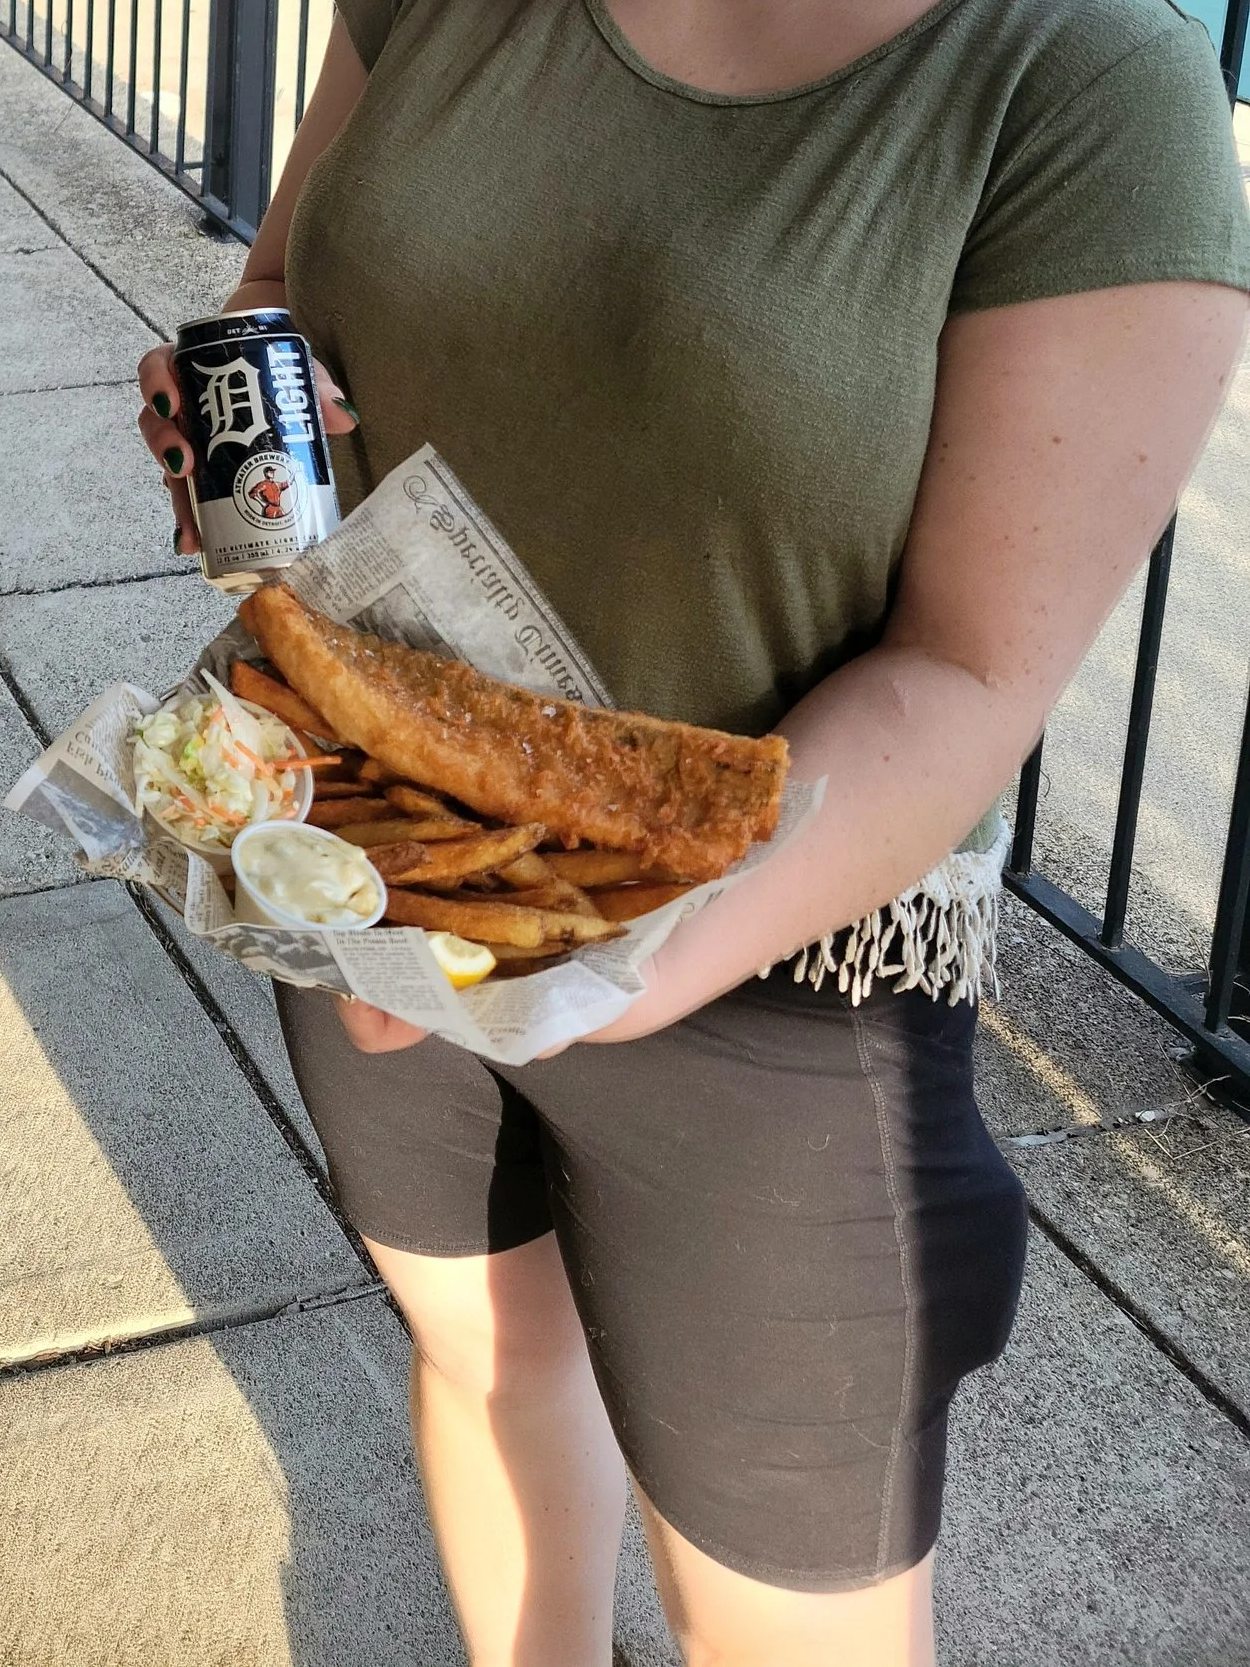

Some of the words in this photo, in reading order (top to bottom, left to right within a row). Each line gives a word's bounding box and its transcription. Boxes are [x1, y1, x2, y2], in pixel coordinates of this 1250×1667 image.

[266, 341, 315, 443] LIGHT
[234, 460, 253, 494] ATWATER
[253, 454, 289, 464] BREWERY
[230, 540, 270, 552] ULTIMATE
[274, 536, 298, 545] LIGHT
